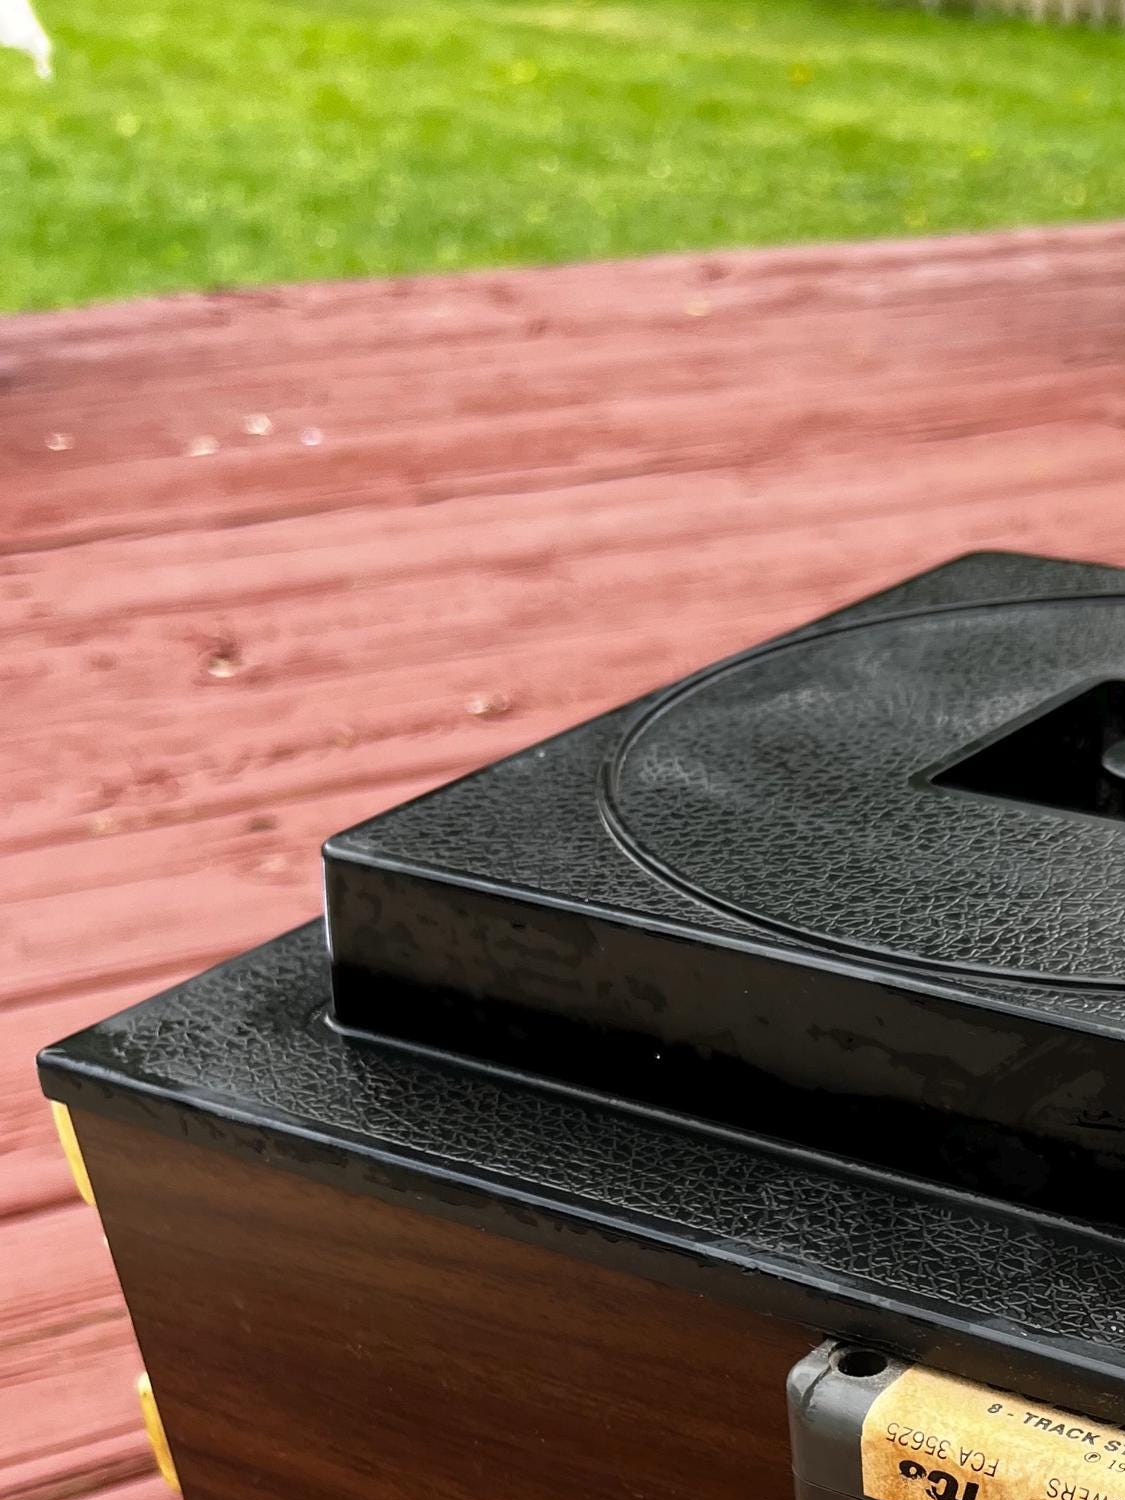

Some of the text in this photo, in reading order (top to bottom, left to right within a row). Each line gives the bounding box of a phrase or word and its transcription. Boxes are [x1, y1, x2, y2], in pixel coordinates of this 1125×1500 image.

[986, 1402, 1003, 1415] 8
[1022, 1411, 1102, 1446] TRACK
[886, 1421, 1001, 1478] FCA 35625
